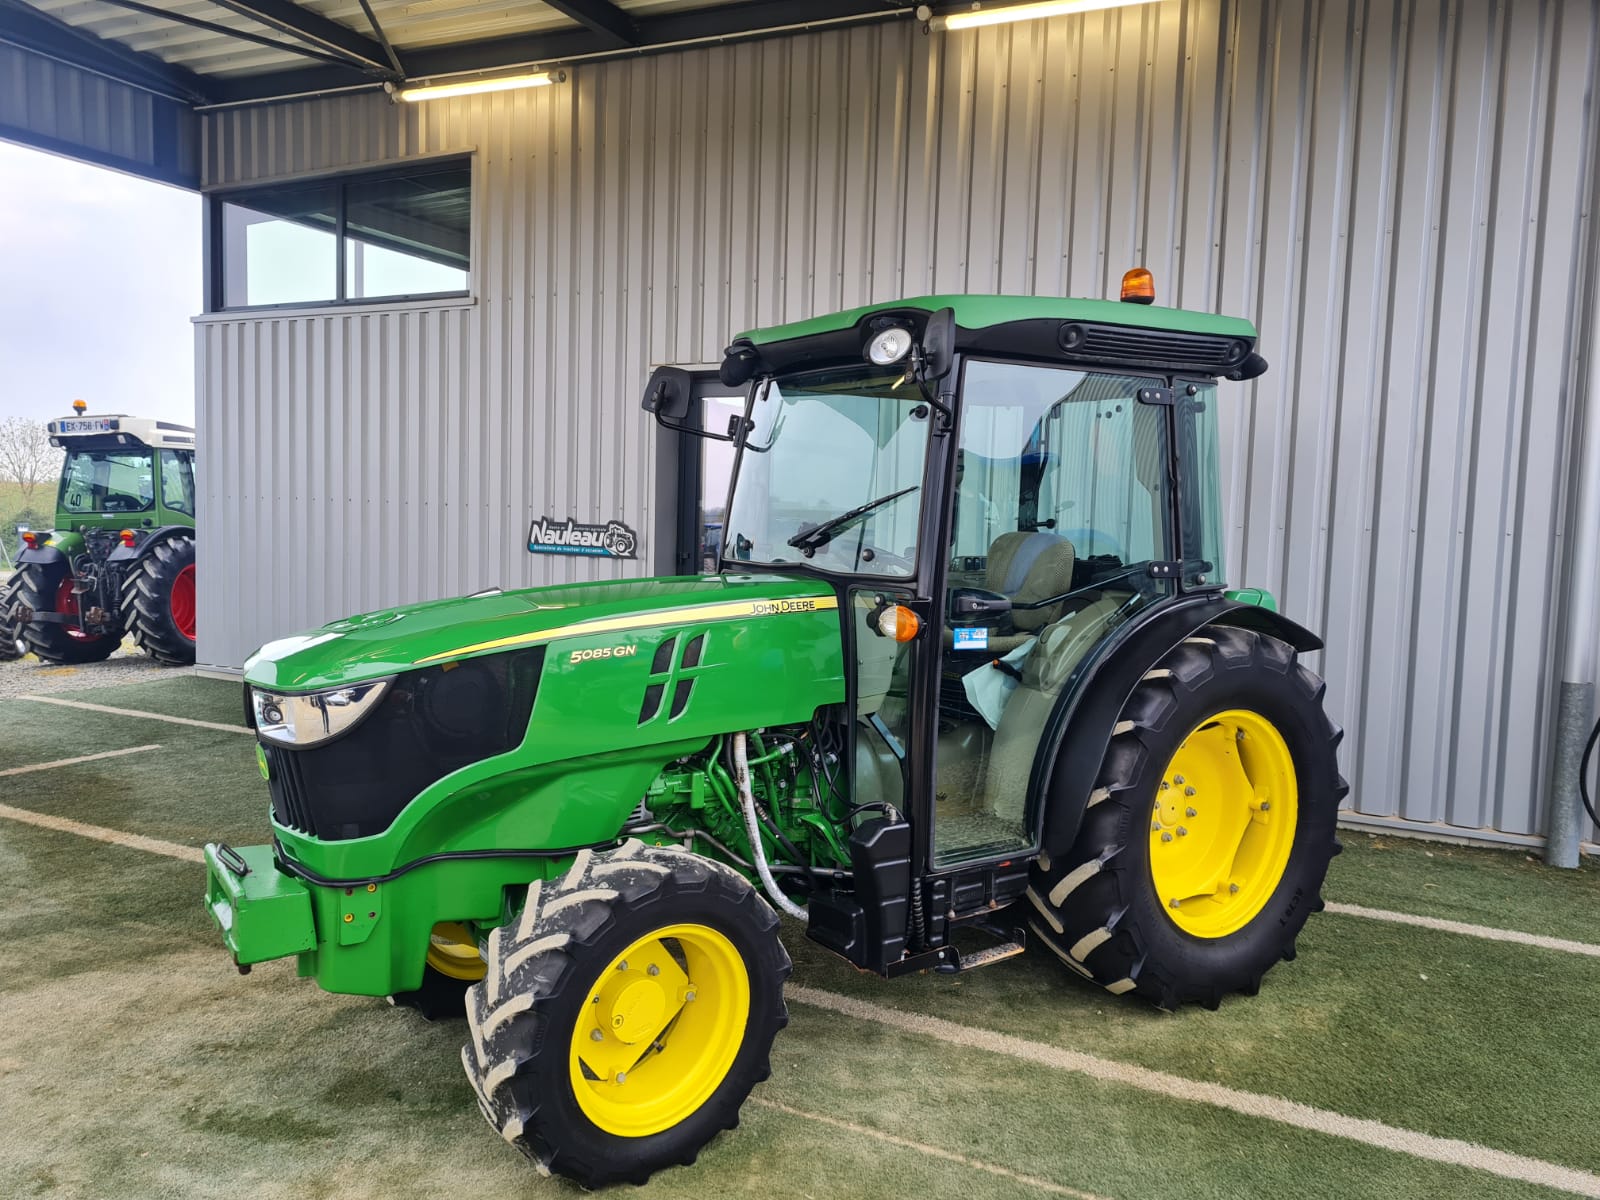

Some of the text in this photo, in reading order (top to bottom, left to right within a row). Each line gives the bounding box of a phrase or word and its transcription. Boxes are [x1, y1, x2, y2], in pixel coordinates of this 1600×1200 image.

[70, 494, 82, 507] 40
[530, 520, 604, 546] Nauleau
[751, 600, 815, 614] JOHN DEERE
[570, 644, 637, 664] 5085 GN
